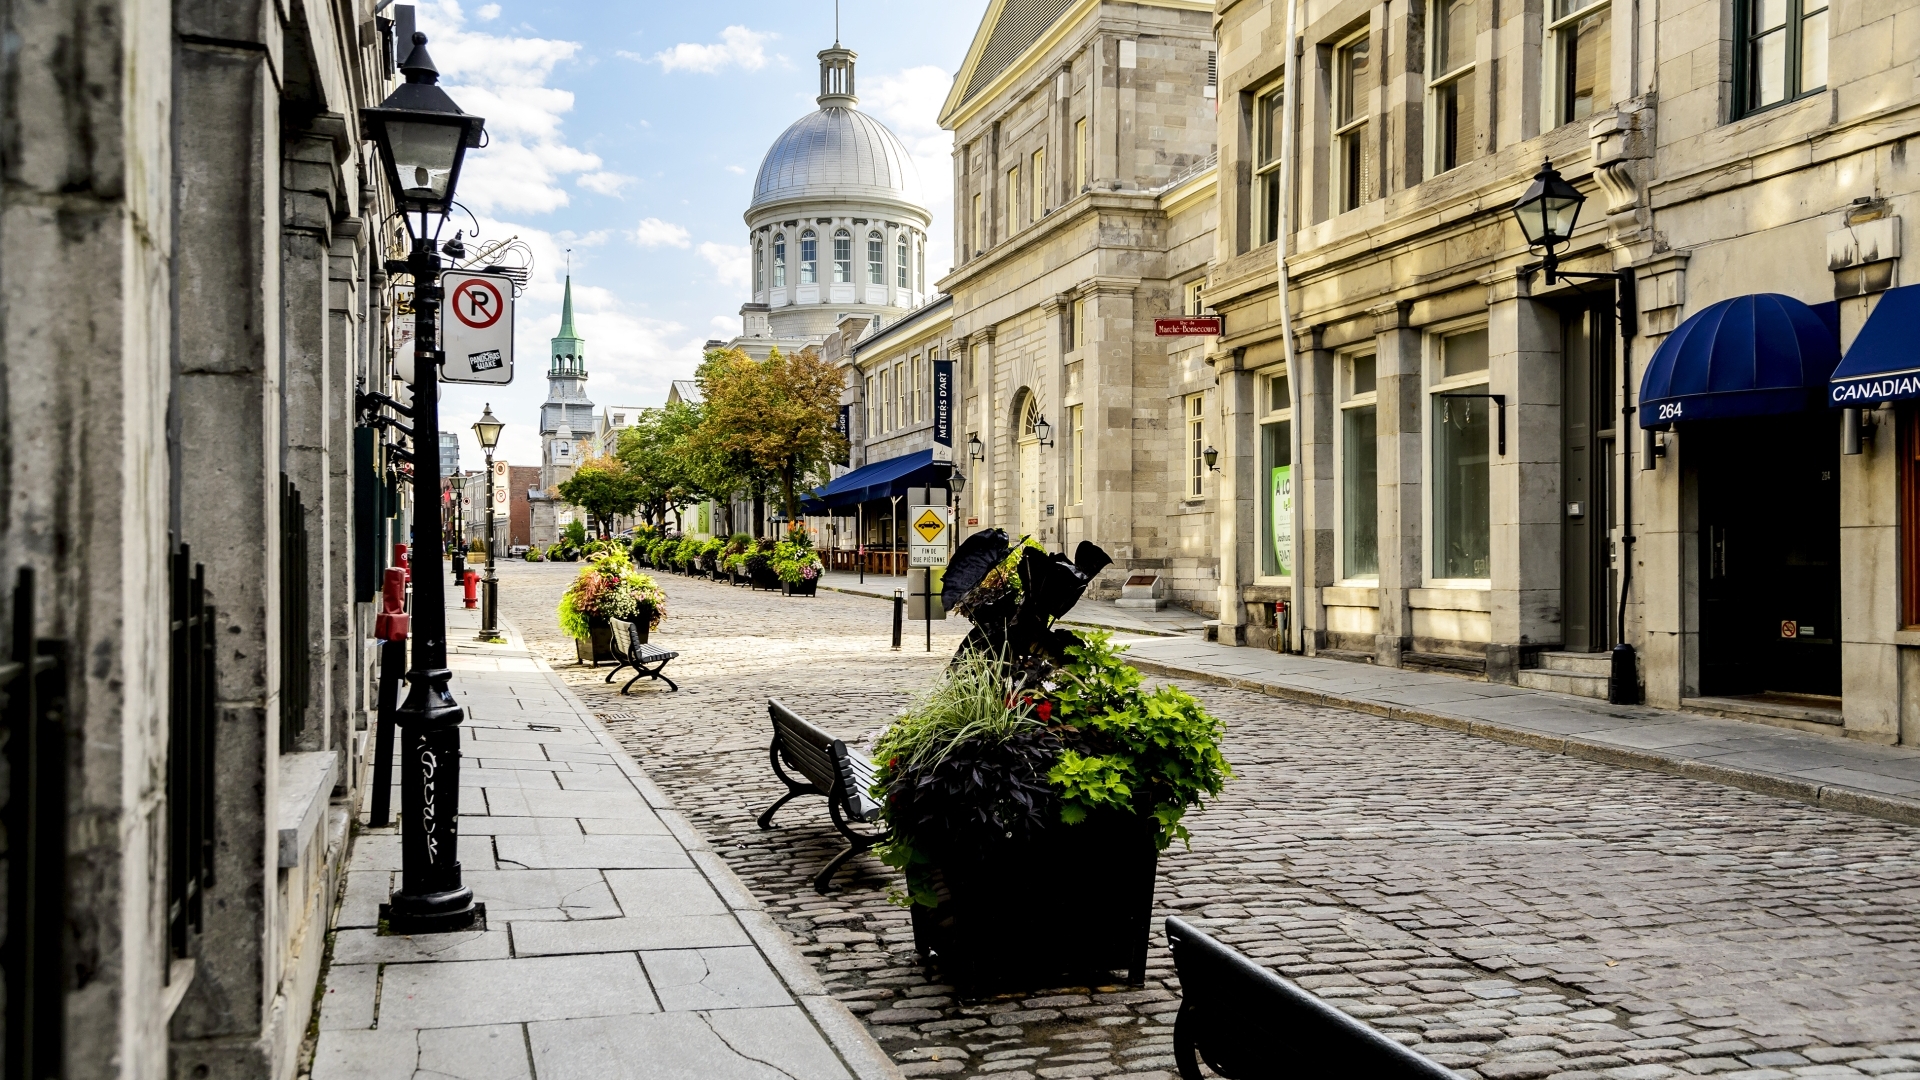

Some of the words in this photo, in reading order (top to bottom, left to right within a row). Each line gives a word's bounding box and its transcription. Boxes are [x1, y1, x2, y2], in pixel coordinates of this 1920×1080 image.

[1159, 325, 1217, 333] Marché-Bonsecours
[939, 372, 947, 397] D'ART
[938, 400, 947, 438] MÉTIERS
[1659, 402, 1682, 419] 264
[1276, 476, 1281, 496] À
[1282, 478, 1290, 495] LO
[924, 555, 945, 563] PIÉTONNE
[1473, 555, 1489, 574] gal
